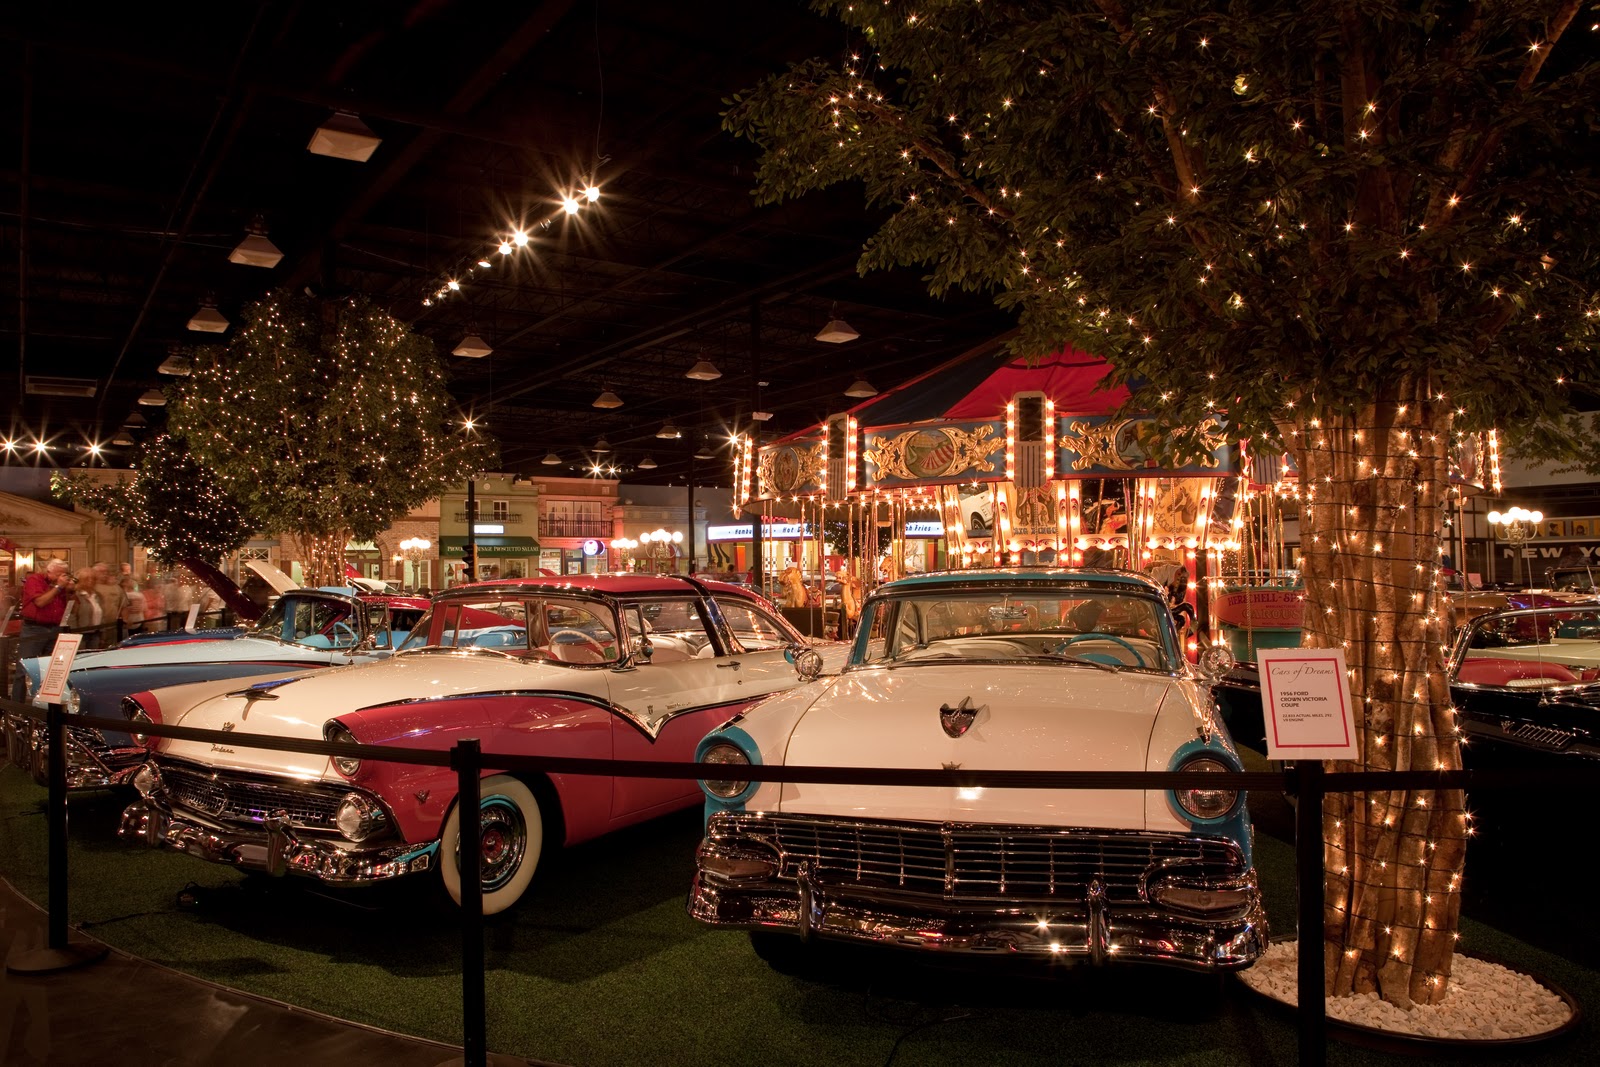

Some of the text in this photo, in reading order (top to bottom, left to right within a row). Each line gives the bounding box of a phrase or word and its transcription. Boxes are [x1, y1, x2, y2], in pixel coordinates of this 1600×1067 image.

[735, 527, 768, 535] Hambus
[914, 524, 931, 532] Fries
[1503, 547, 1563, 559] NEW
[1241, 608, 1304, 620] CAROUS
[1271, 663, 1334, 683] Cars of Dreams
